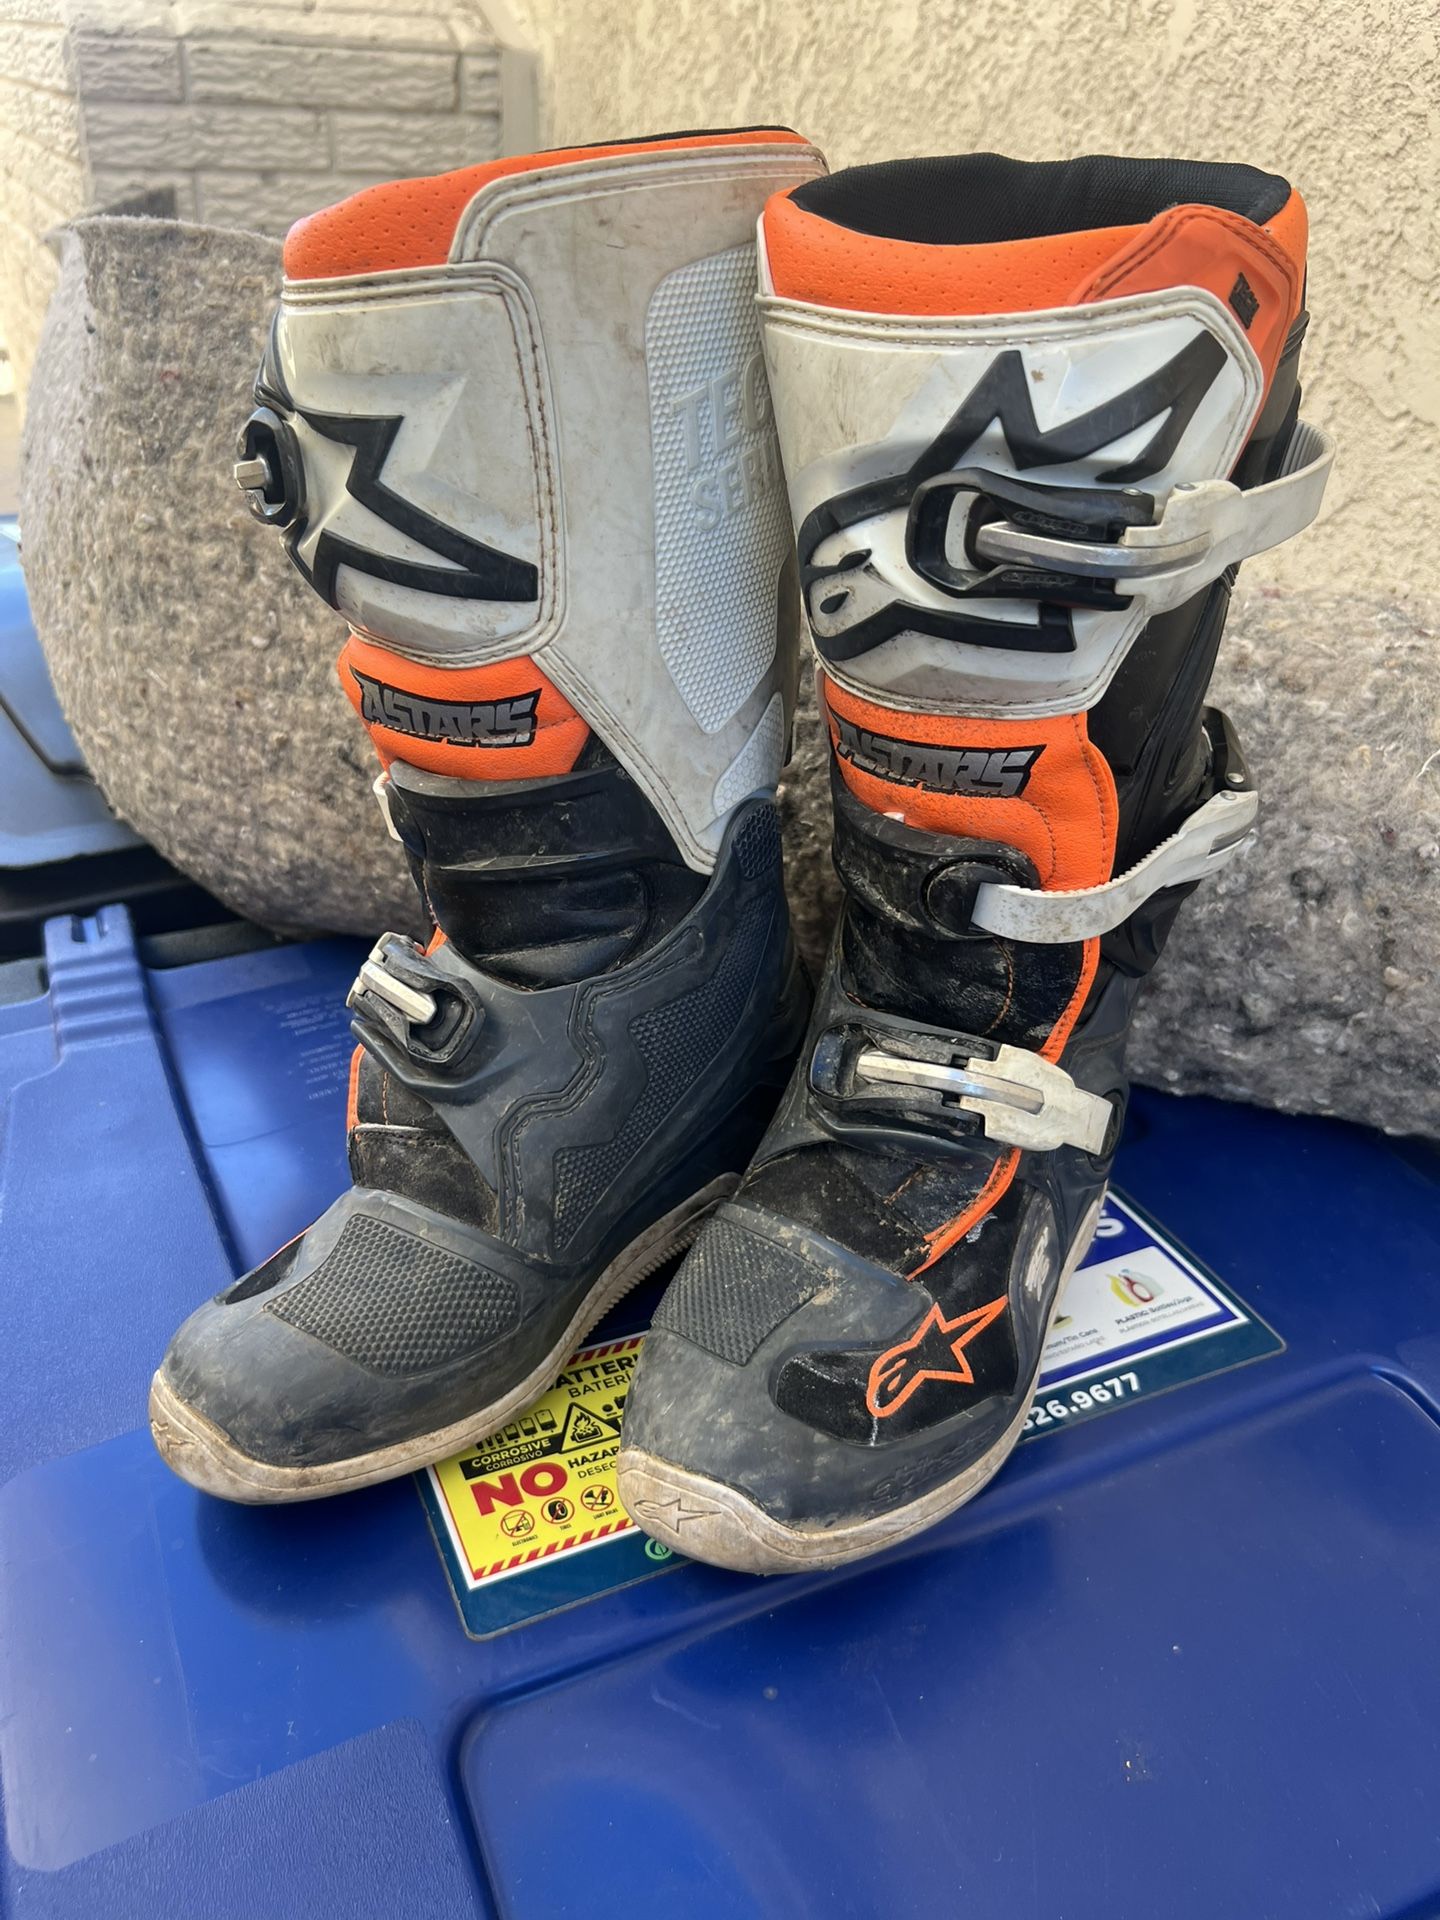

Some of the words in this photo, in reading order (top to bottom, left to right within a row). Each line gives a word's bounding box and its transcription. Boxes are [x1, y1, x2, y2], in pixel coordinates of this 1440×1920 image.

[351, 665, 541, 747] ASTARS
[471, 1438, 551, 1467] CORROSIVE
[486, 1450, 543, 1472] CORROSIVO
[470, 1462, 568, 1516] NO
